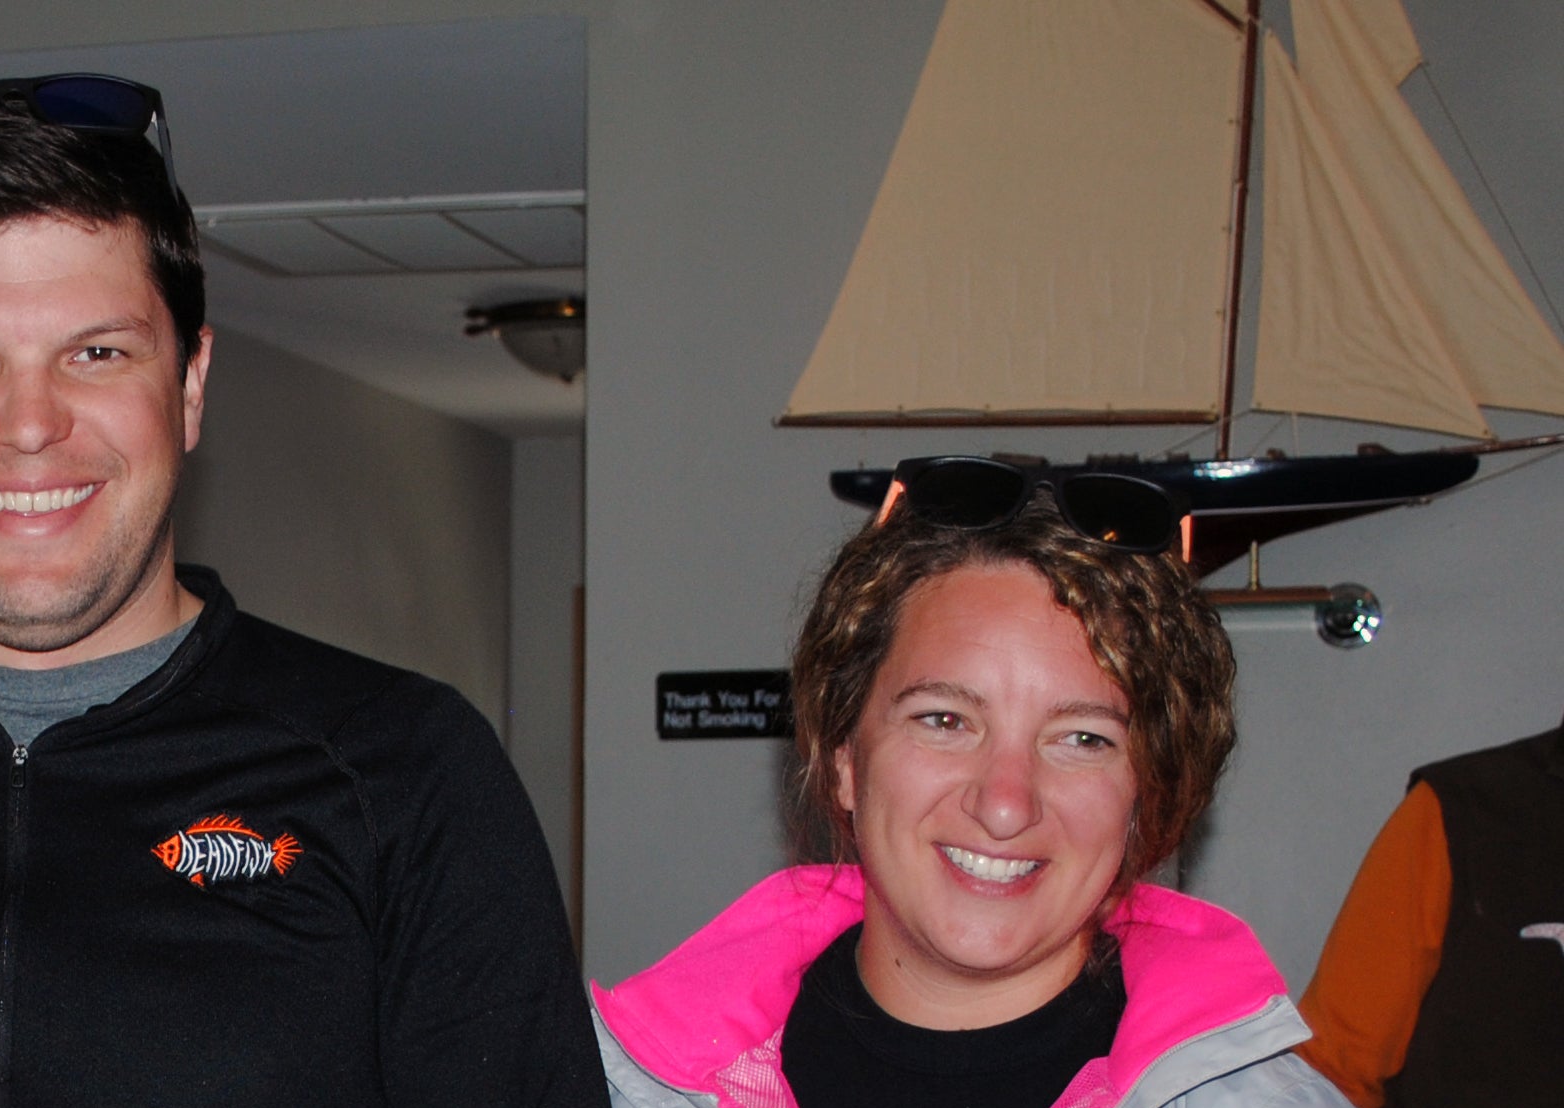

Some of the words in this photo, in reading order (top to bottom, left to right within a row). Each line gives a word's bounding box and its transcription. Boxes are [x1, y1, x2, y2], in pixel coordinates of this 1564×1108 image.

[664, 691, 711, 708] Thank
[718, 690, 749, 707] You
[754, 690, 781, 706] For
[663, 711, 693, 728] Not
[698, 710, 767, 730] Smoking
[176, 830, 276, 881] DEADFISH
